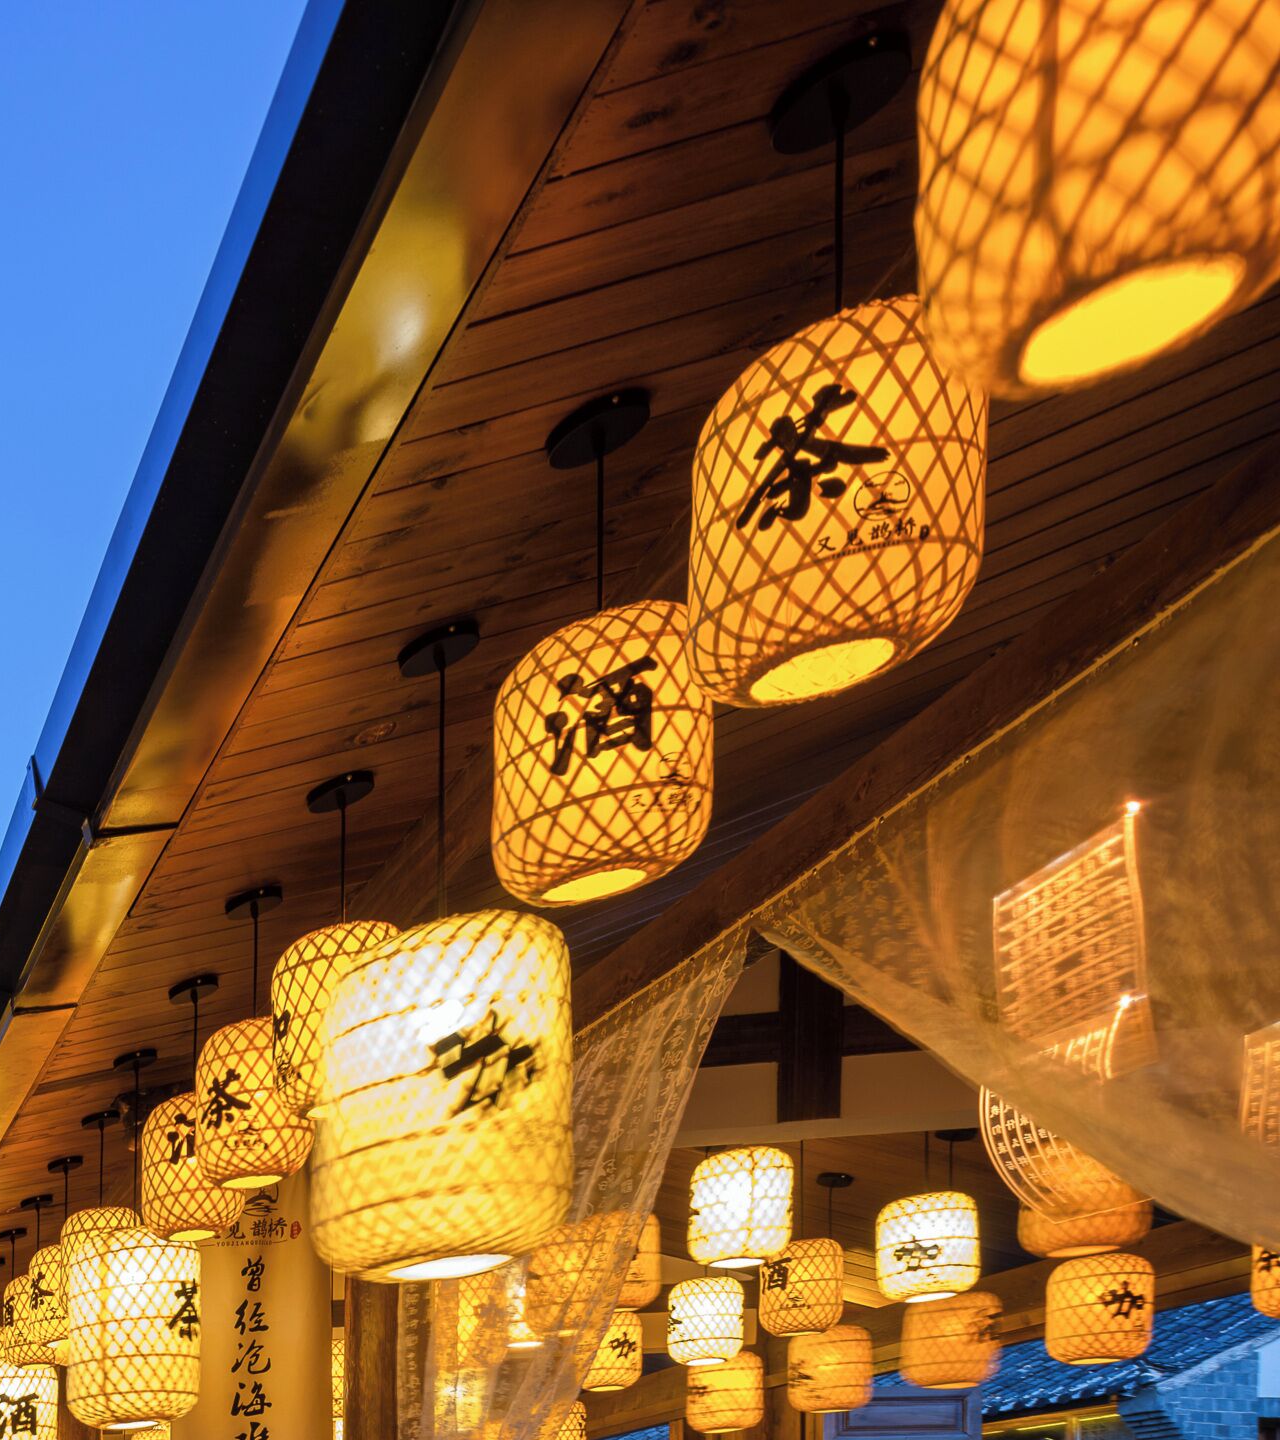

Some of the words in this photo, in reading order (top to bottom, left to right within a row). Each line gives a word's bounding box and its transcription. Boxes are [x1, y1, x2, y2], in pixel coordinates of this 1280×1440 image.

[734, 382, 891, 532] 茶
[543, 655, 658, 777] 酒
[200, 1068, 252, 1130] 茶
